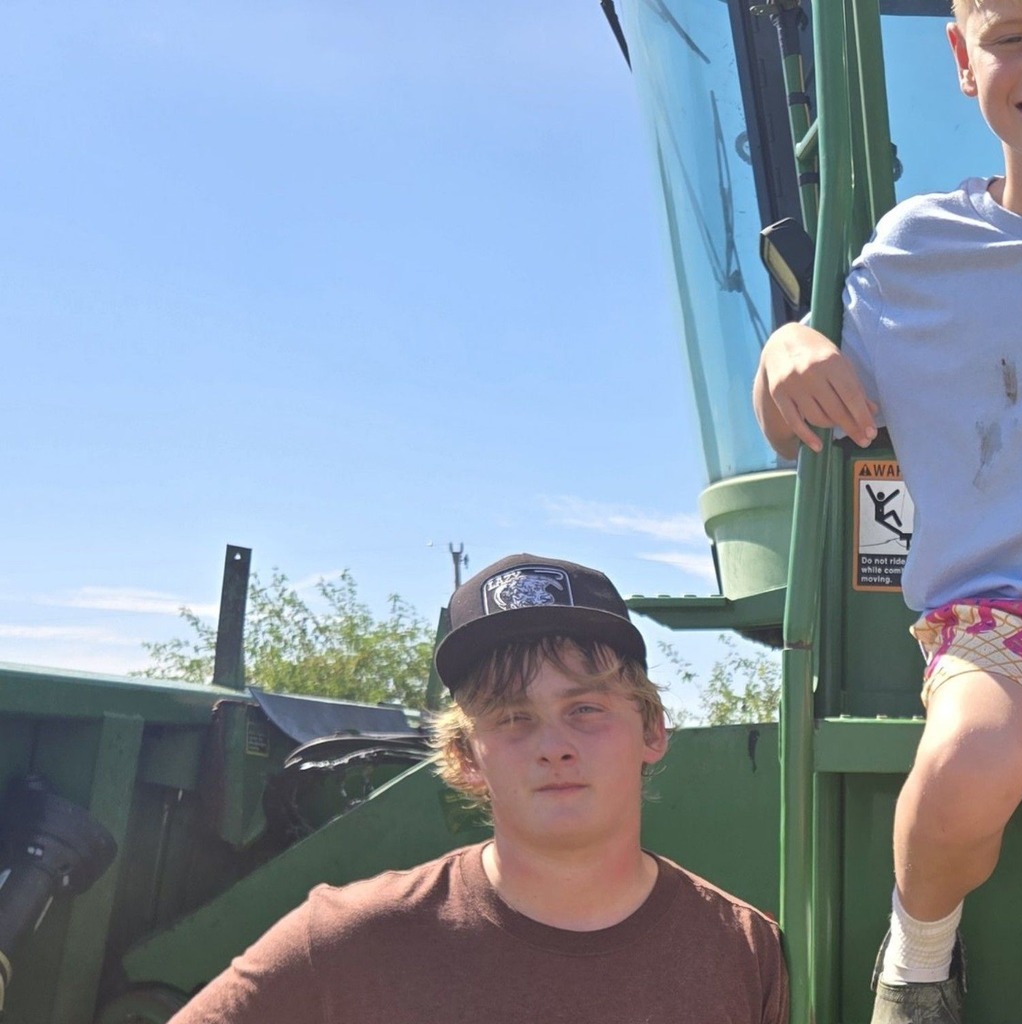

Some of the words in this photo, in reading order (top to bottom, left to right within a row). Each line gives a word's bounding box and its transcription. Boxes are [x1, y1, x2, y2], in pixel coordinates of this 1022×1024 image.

[861, 556, 873, 565] Do
[874, 557, 888, 565] not
[889, 557, 906, 565] ride
[861, 566, 882, 574] while
[861, 575, 893, 585] moving.
